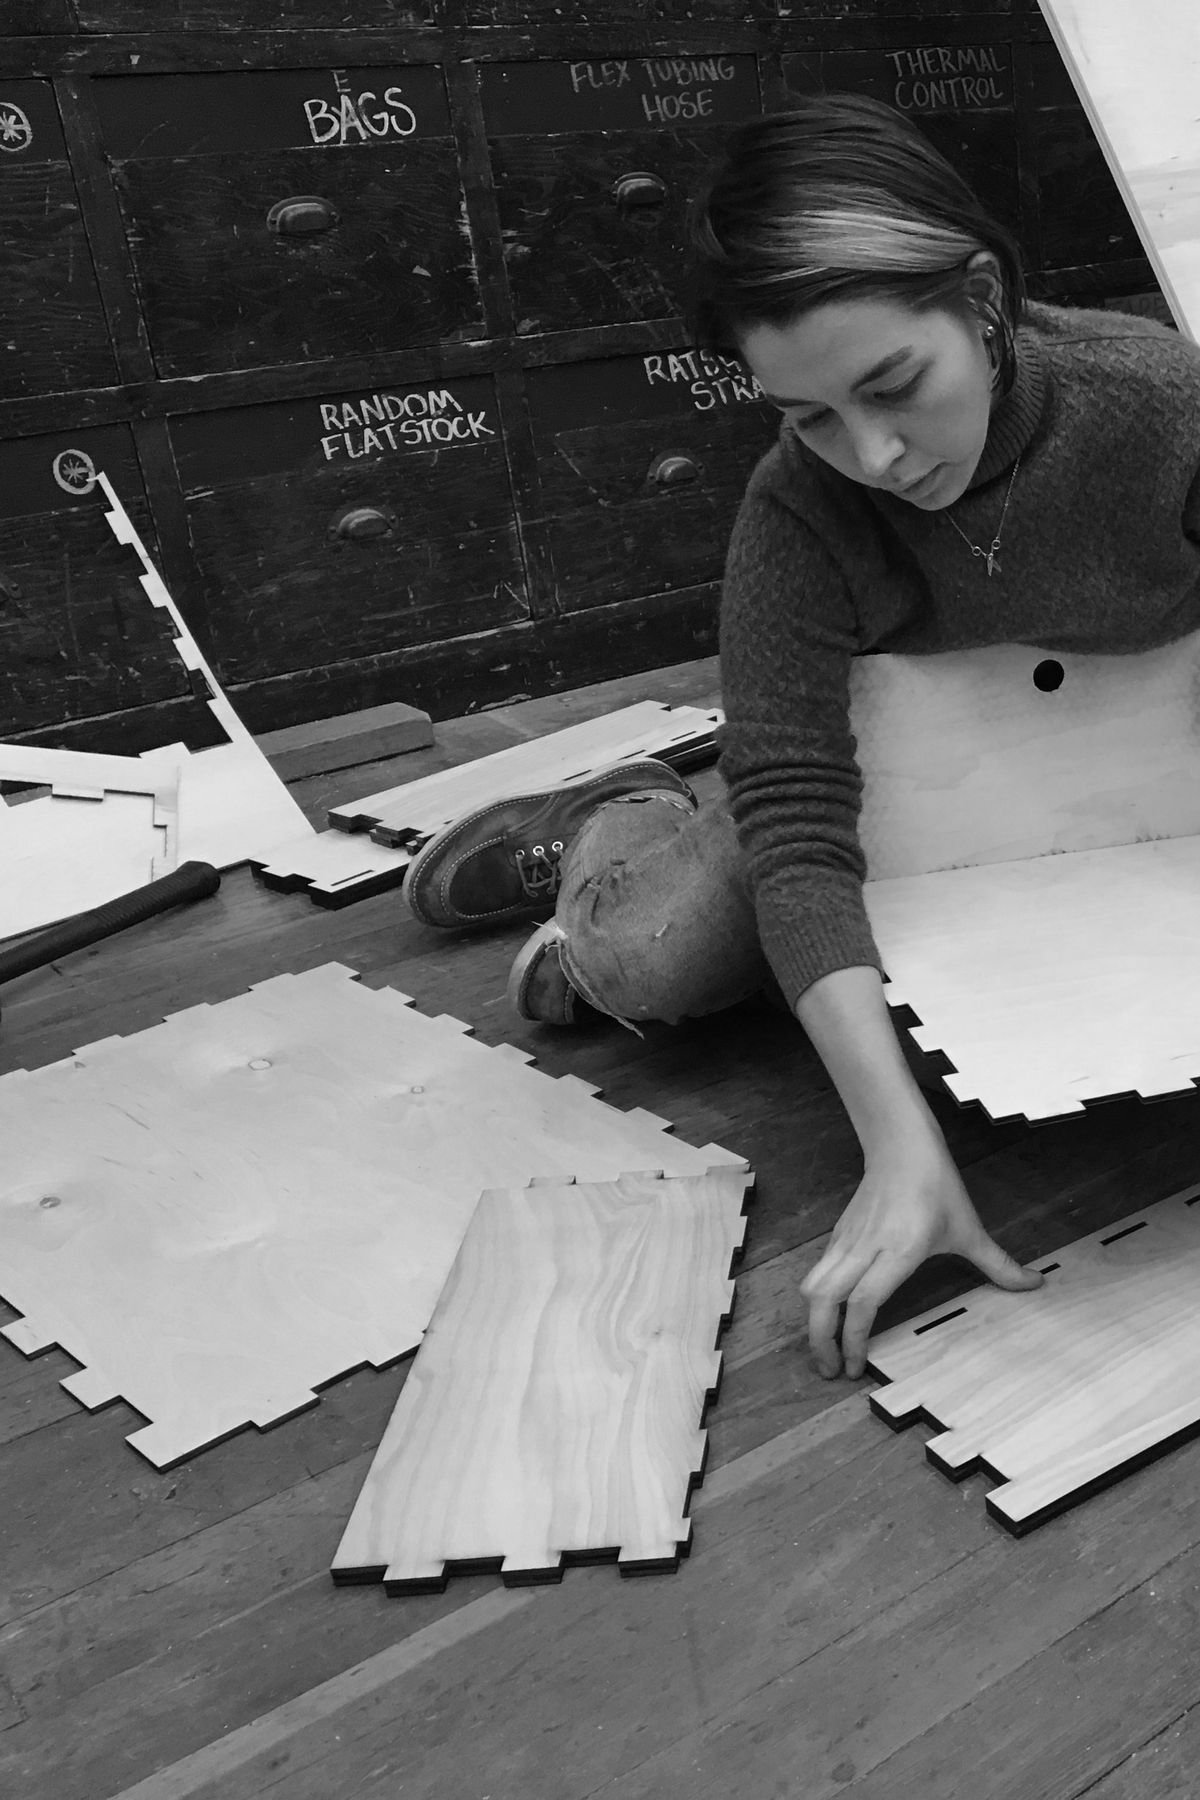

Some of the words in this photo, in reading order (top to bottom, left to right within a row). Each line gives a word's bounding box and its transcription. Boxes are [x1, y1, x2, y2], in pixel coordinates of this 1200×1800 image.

[570, 60, 631, 93] FLEX
[641, 57, 735, 88] TUBING
[885, 47, 1007, 77] THERMAL
[641, 89, 713, 122] HOSE
[895, 76, 1004, 109] CONTROL
[690, 375, 765, 410] STRA
[319, 389, 463, 431] RANDOM
